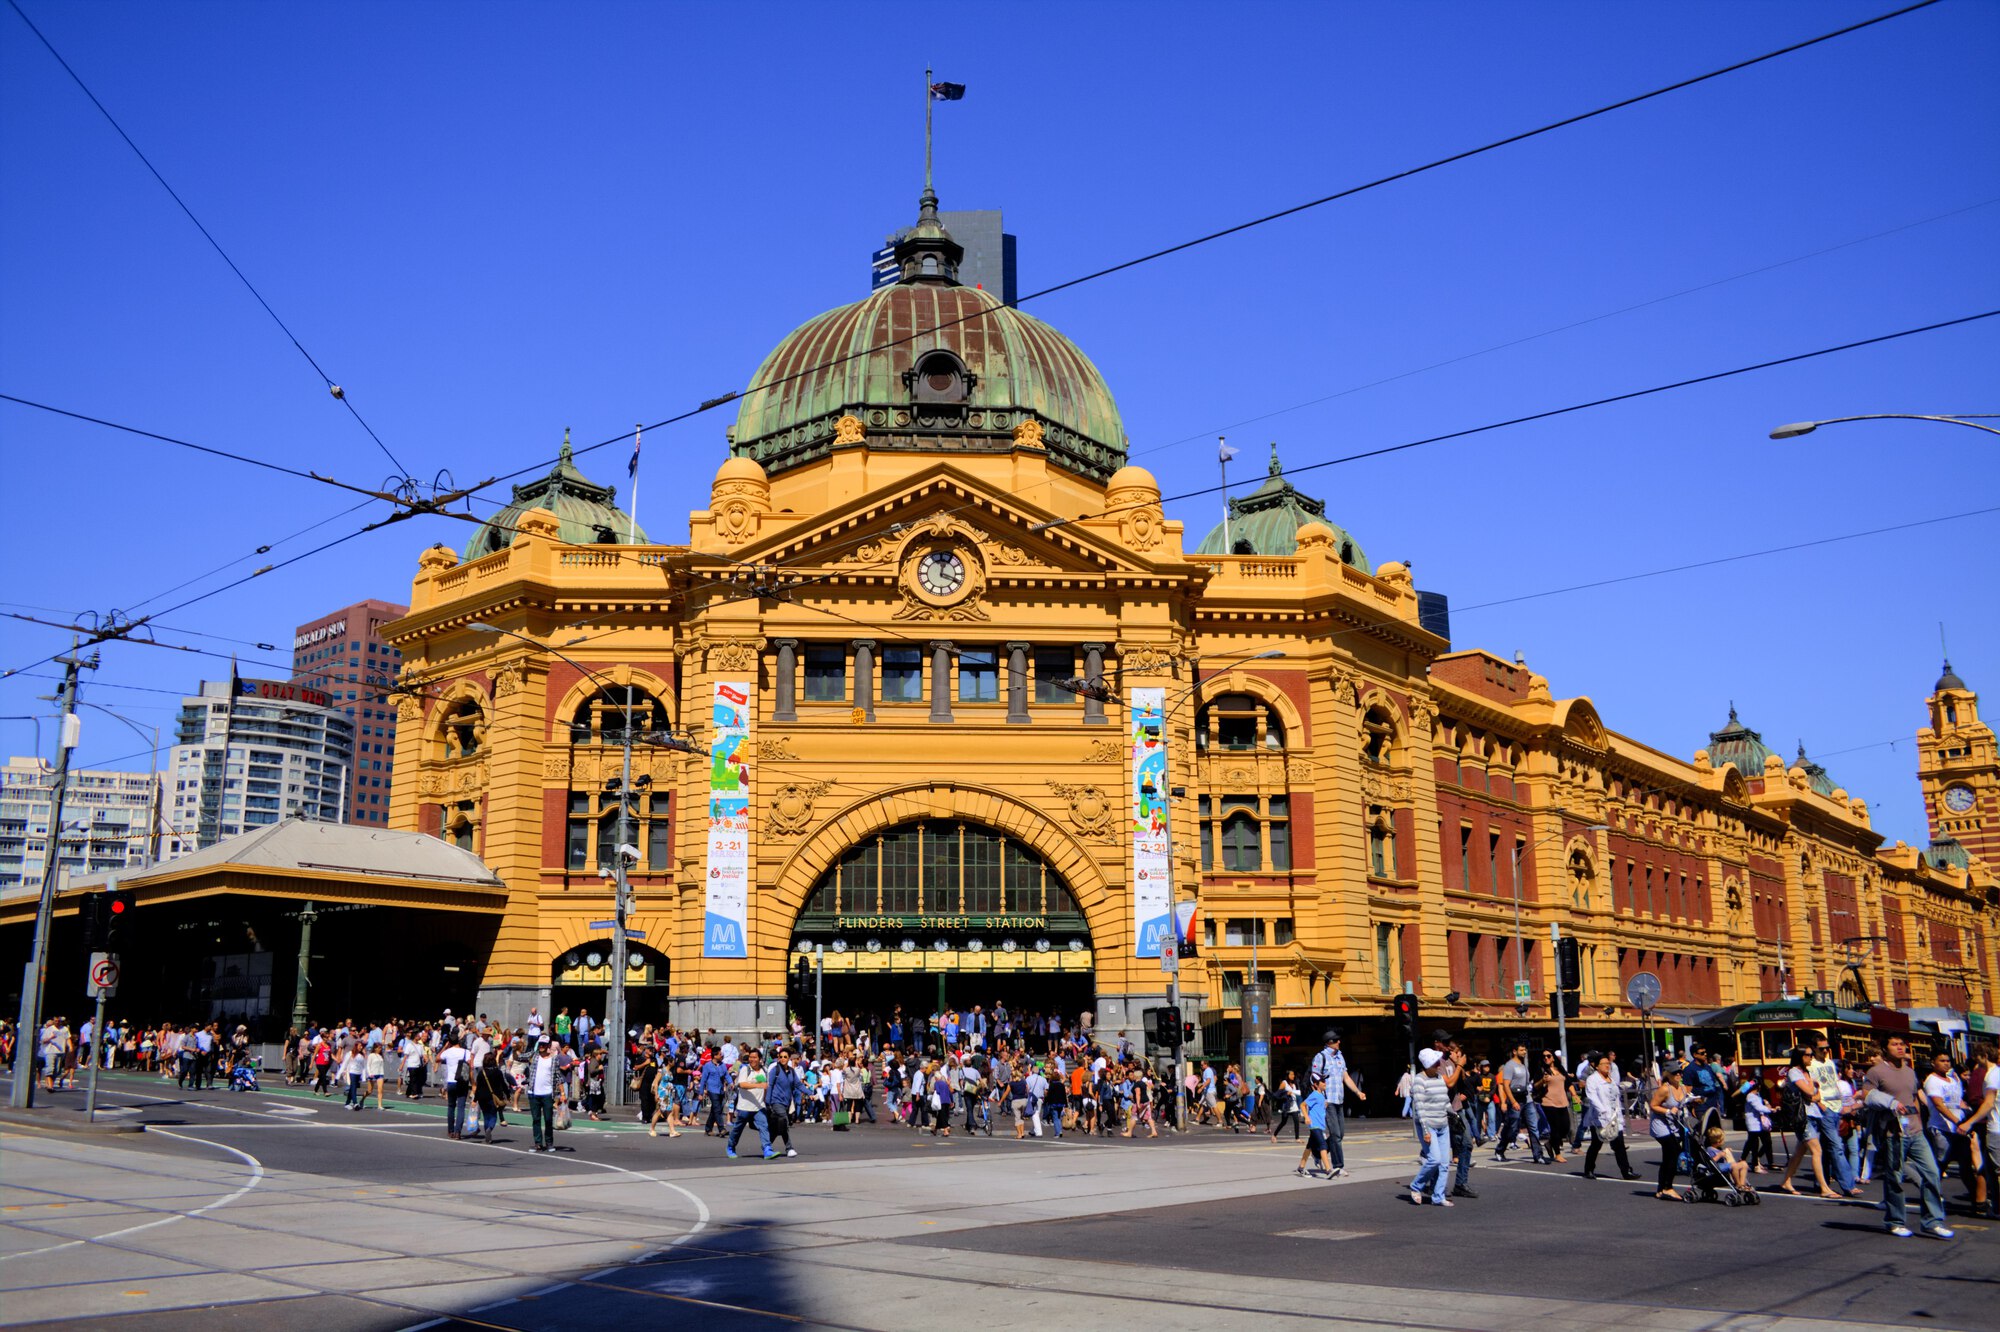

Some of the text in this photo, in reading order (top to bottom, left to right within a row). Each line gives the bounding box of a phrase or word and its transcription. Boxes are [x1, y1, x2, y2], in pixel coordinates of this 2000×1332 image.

[328, 619, 347, 637] SUN
[261, 683, 295, 699] QUAY
[715, 840, 742, 850] 2-21
[838, 917, 1045, 929] FLINDERS STREET STATION
[1815, 993, 1832, 1004] 35
[1774, 1012, 1794, 1020] CIRCLE
[1270, 1035, 1291, 1044] ITY
